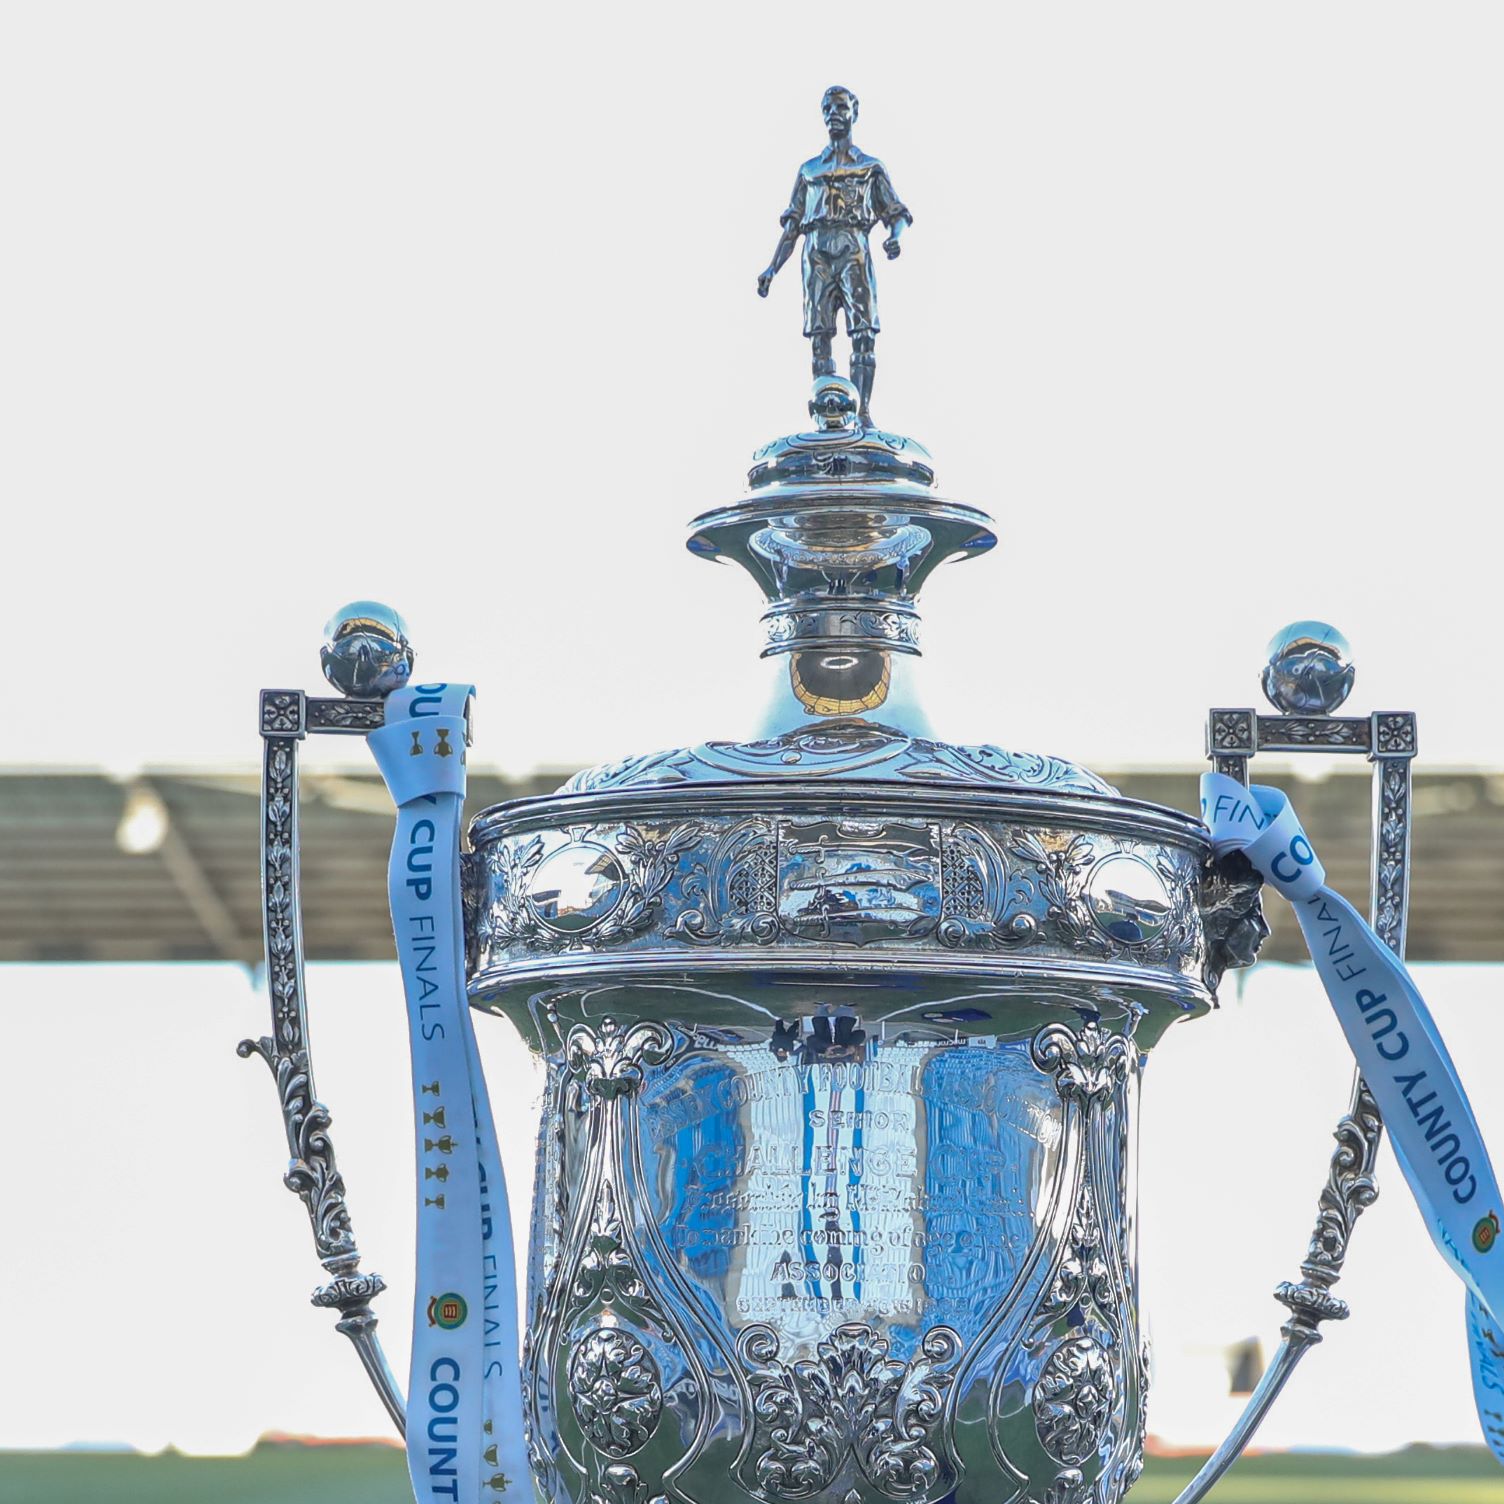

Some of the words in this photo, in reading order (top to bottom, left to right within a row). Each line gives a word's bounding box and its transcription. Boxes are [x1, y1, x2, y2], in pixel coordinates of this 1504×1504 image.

[406, 818, 436, 902] CUP
[409, 914, 445, 1042] FINALS
[1355, 988, 1410, 1061] CUP
[1393, 1070, 1477, 1205] COUNTY
